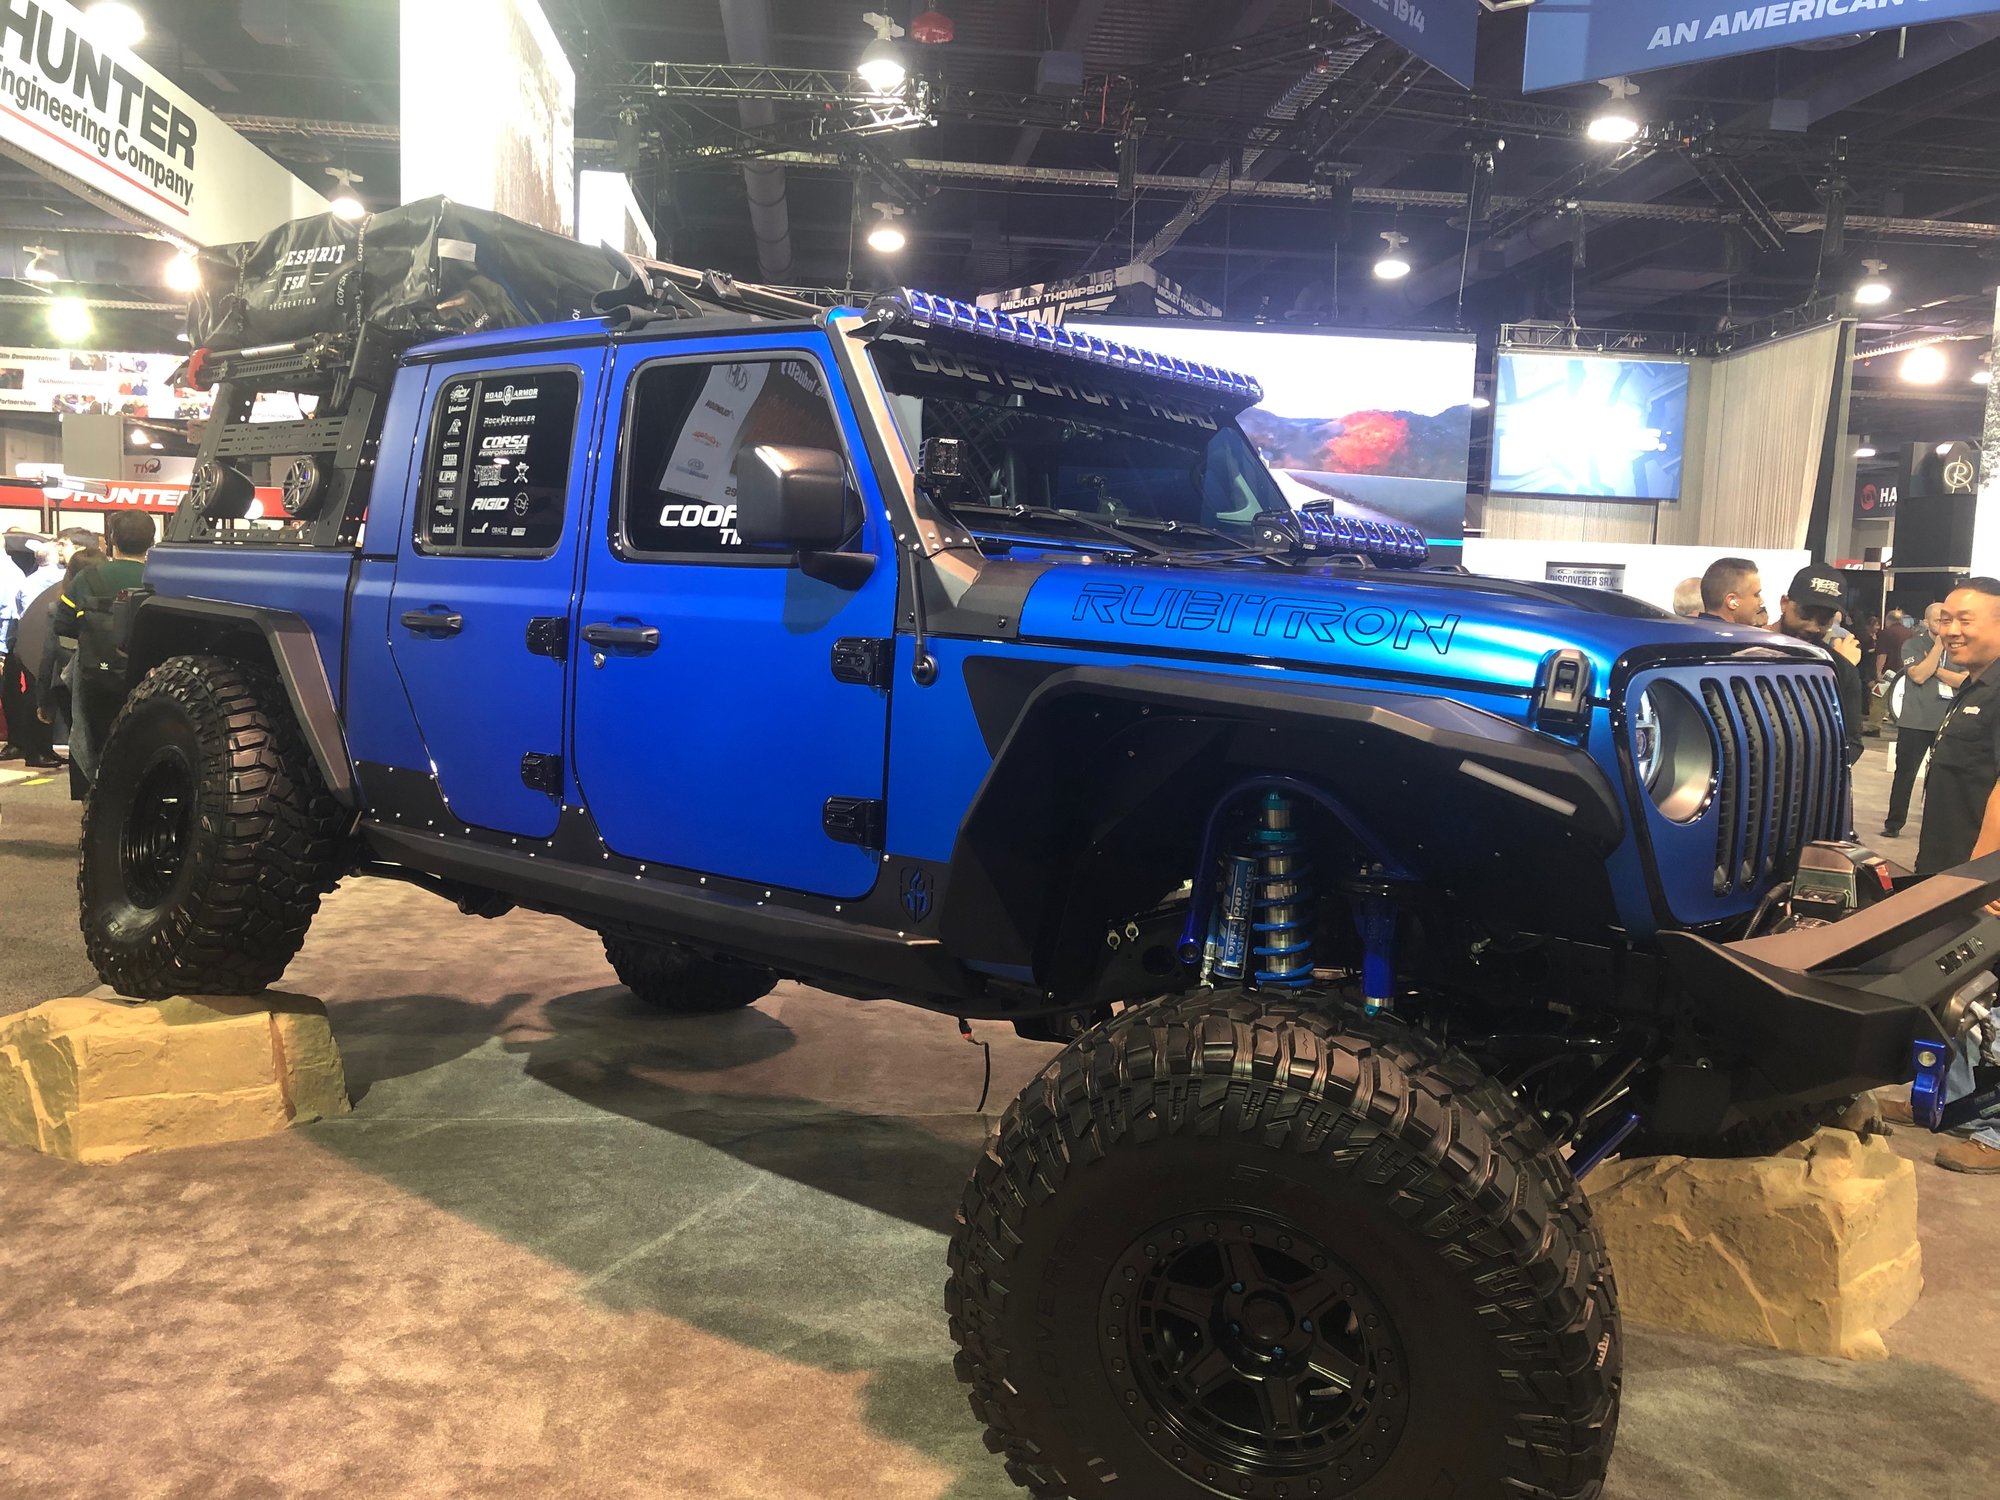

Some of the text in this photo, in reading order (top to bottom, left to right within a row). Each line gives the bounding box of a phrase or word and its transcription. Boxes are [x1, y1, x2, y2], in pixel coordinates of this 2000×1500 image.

[1393, 0, 1425, 33] 1914
[1647, 20, 1700, 50] AN
[0, 0, 197, 170] HUNTER
[0, 53, 194, 205] ngineering Company
[283, 275, 307, 291] FSR
[269, 297, 316, 311] RECREATION
[1000, 282, 1113, 311] MICKEY THOMPSON
[485, 388, 538, 399] ROAD ARMOR
[482, 435, 530, 449] CORSA
[471, 497, 509, 511] RIGID
[1550, 574, 1597, 587] DISCOVERER
[1072, 582, 1461, 655] RUBITRON
